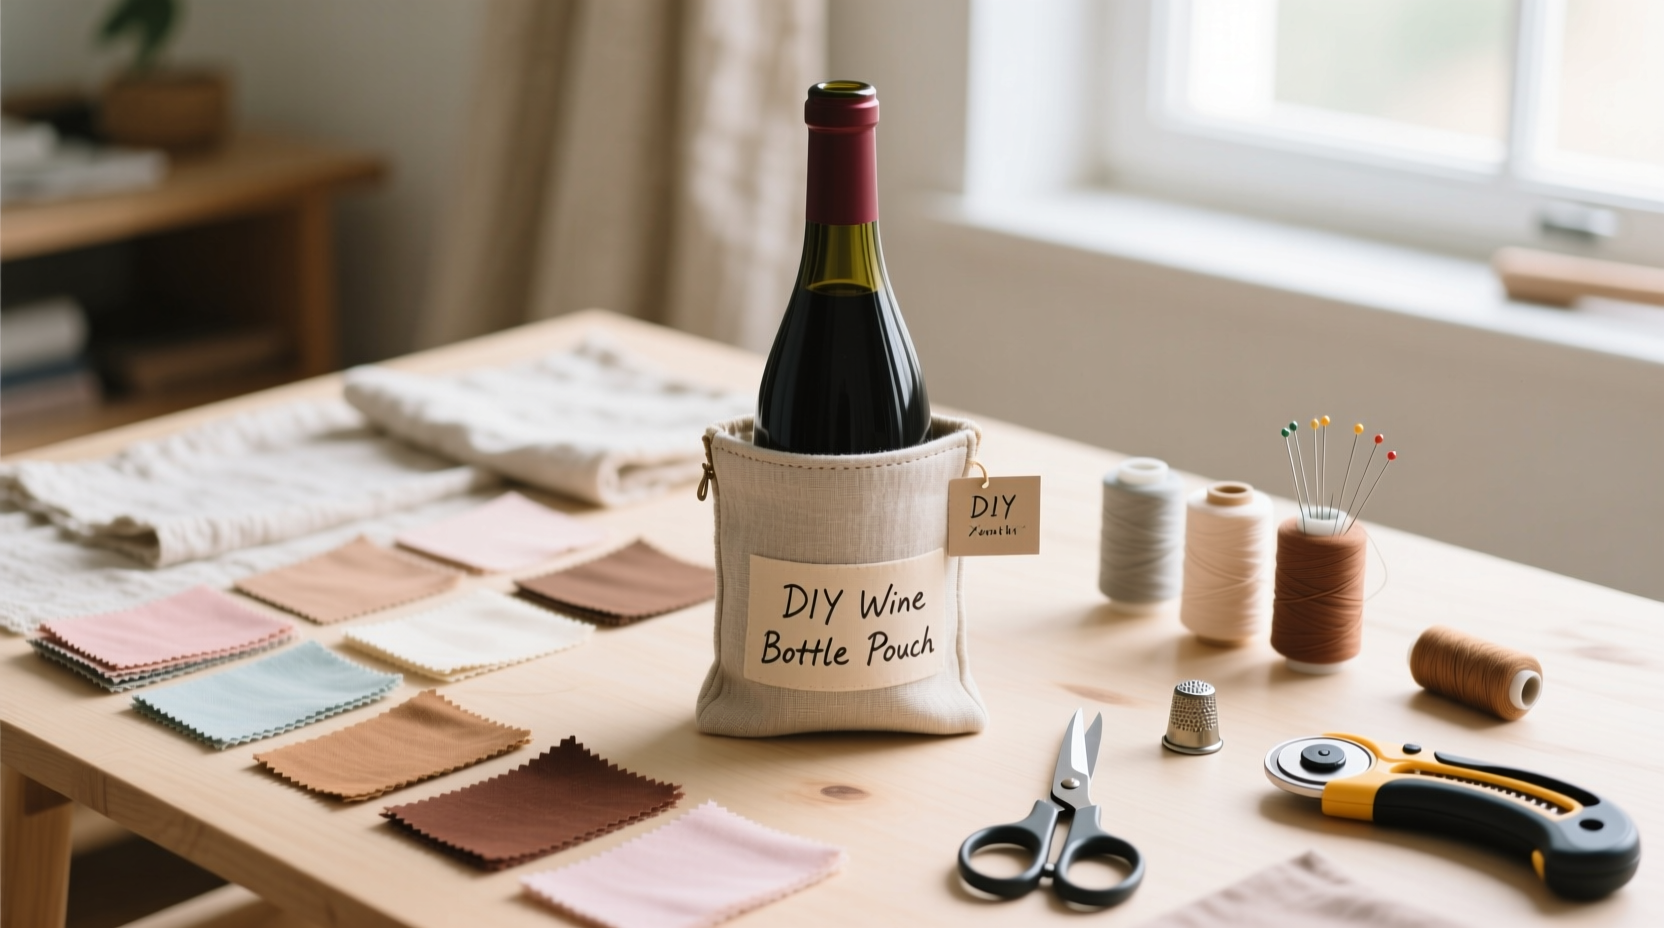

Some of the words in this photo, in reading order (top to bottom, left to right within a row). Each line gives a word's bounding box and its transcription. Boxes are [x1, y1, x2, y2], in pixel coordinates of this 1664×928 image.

[970, 494, 1017, 520] DIY
[782, 583, 844, 626] DIY
[860, 583, 926, 620] Wine
[761, 629, 850, 667] Bottle
[866, 625, 935, 667] Pouch
